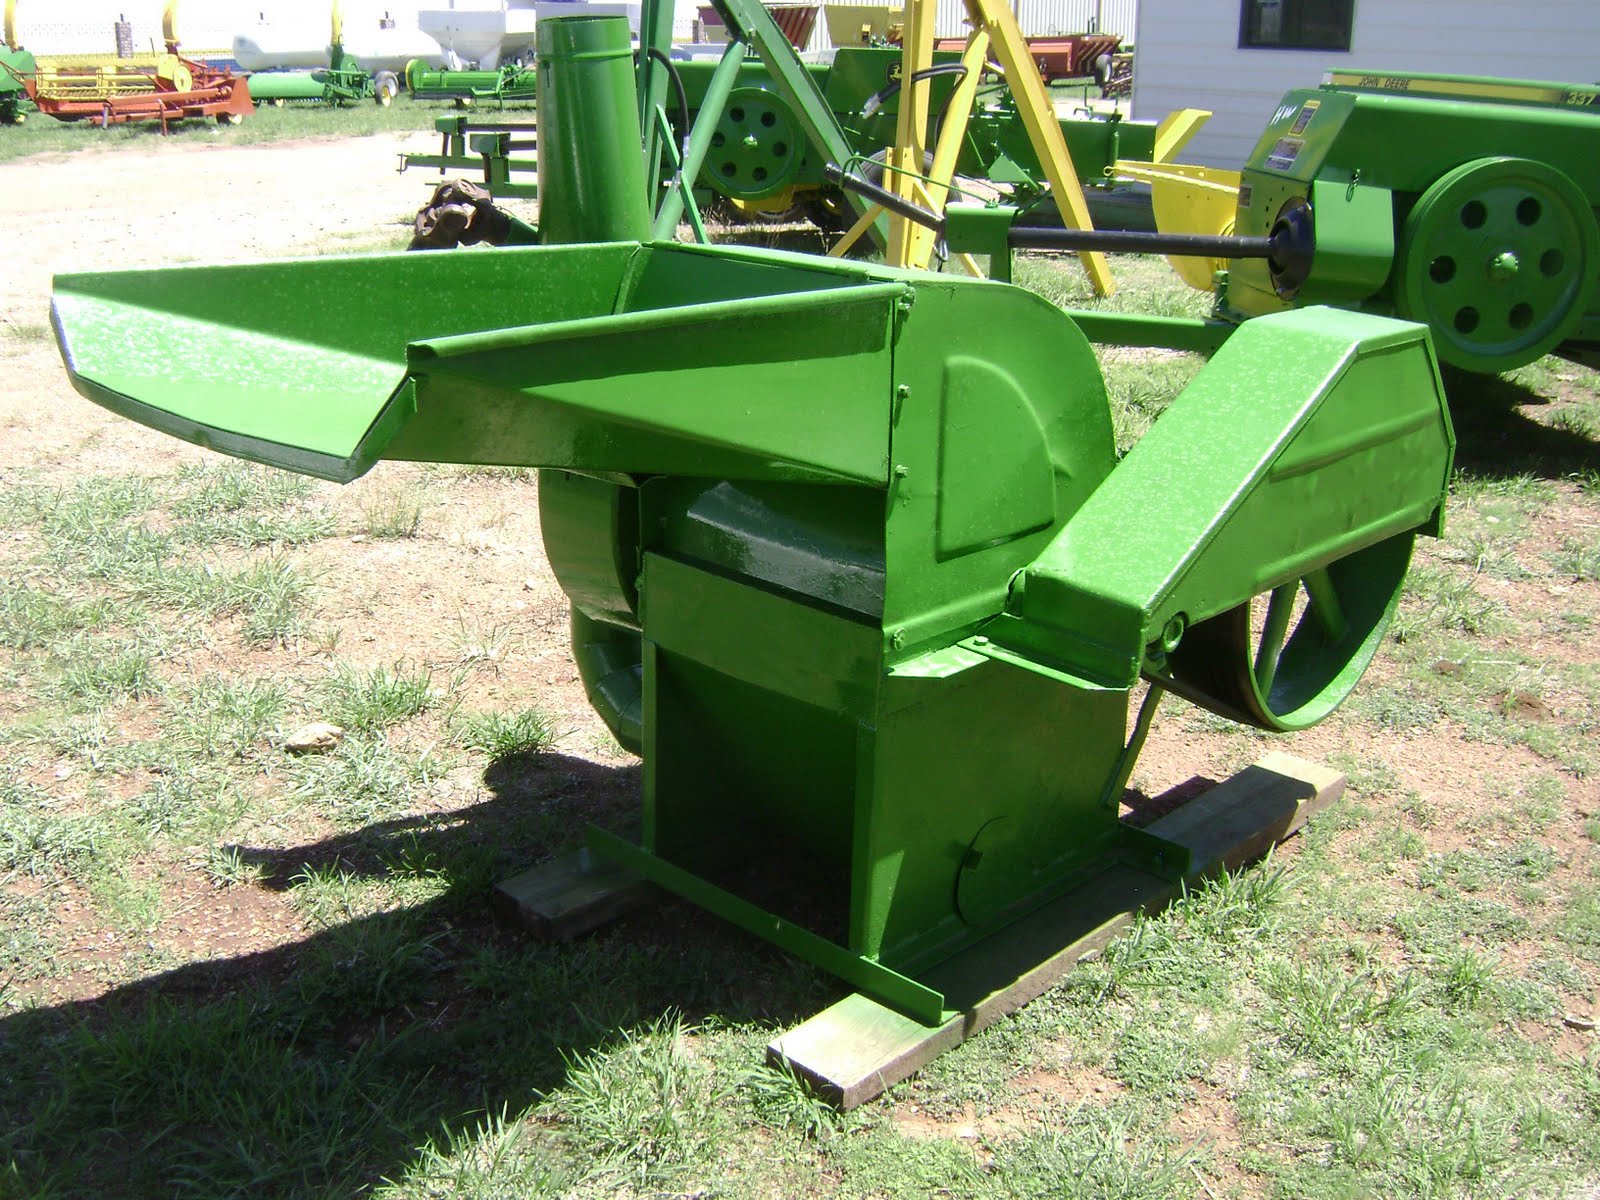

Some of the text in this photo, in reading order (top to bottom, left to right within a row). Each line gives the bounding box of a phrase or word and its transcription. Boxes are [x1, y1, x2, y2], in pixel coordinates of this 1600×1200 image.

[1359, 76, 1411, 89] JOHN DEERE
[1567, 92, 1596, 106] 337
